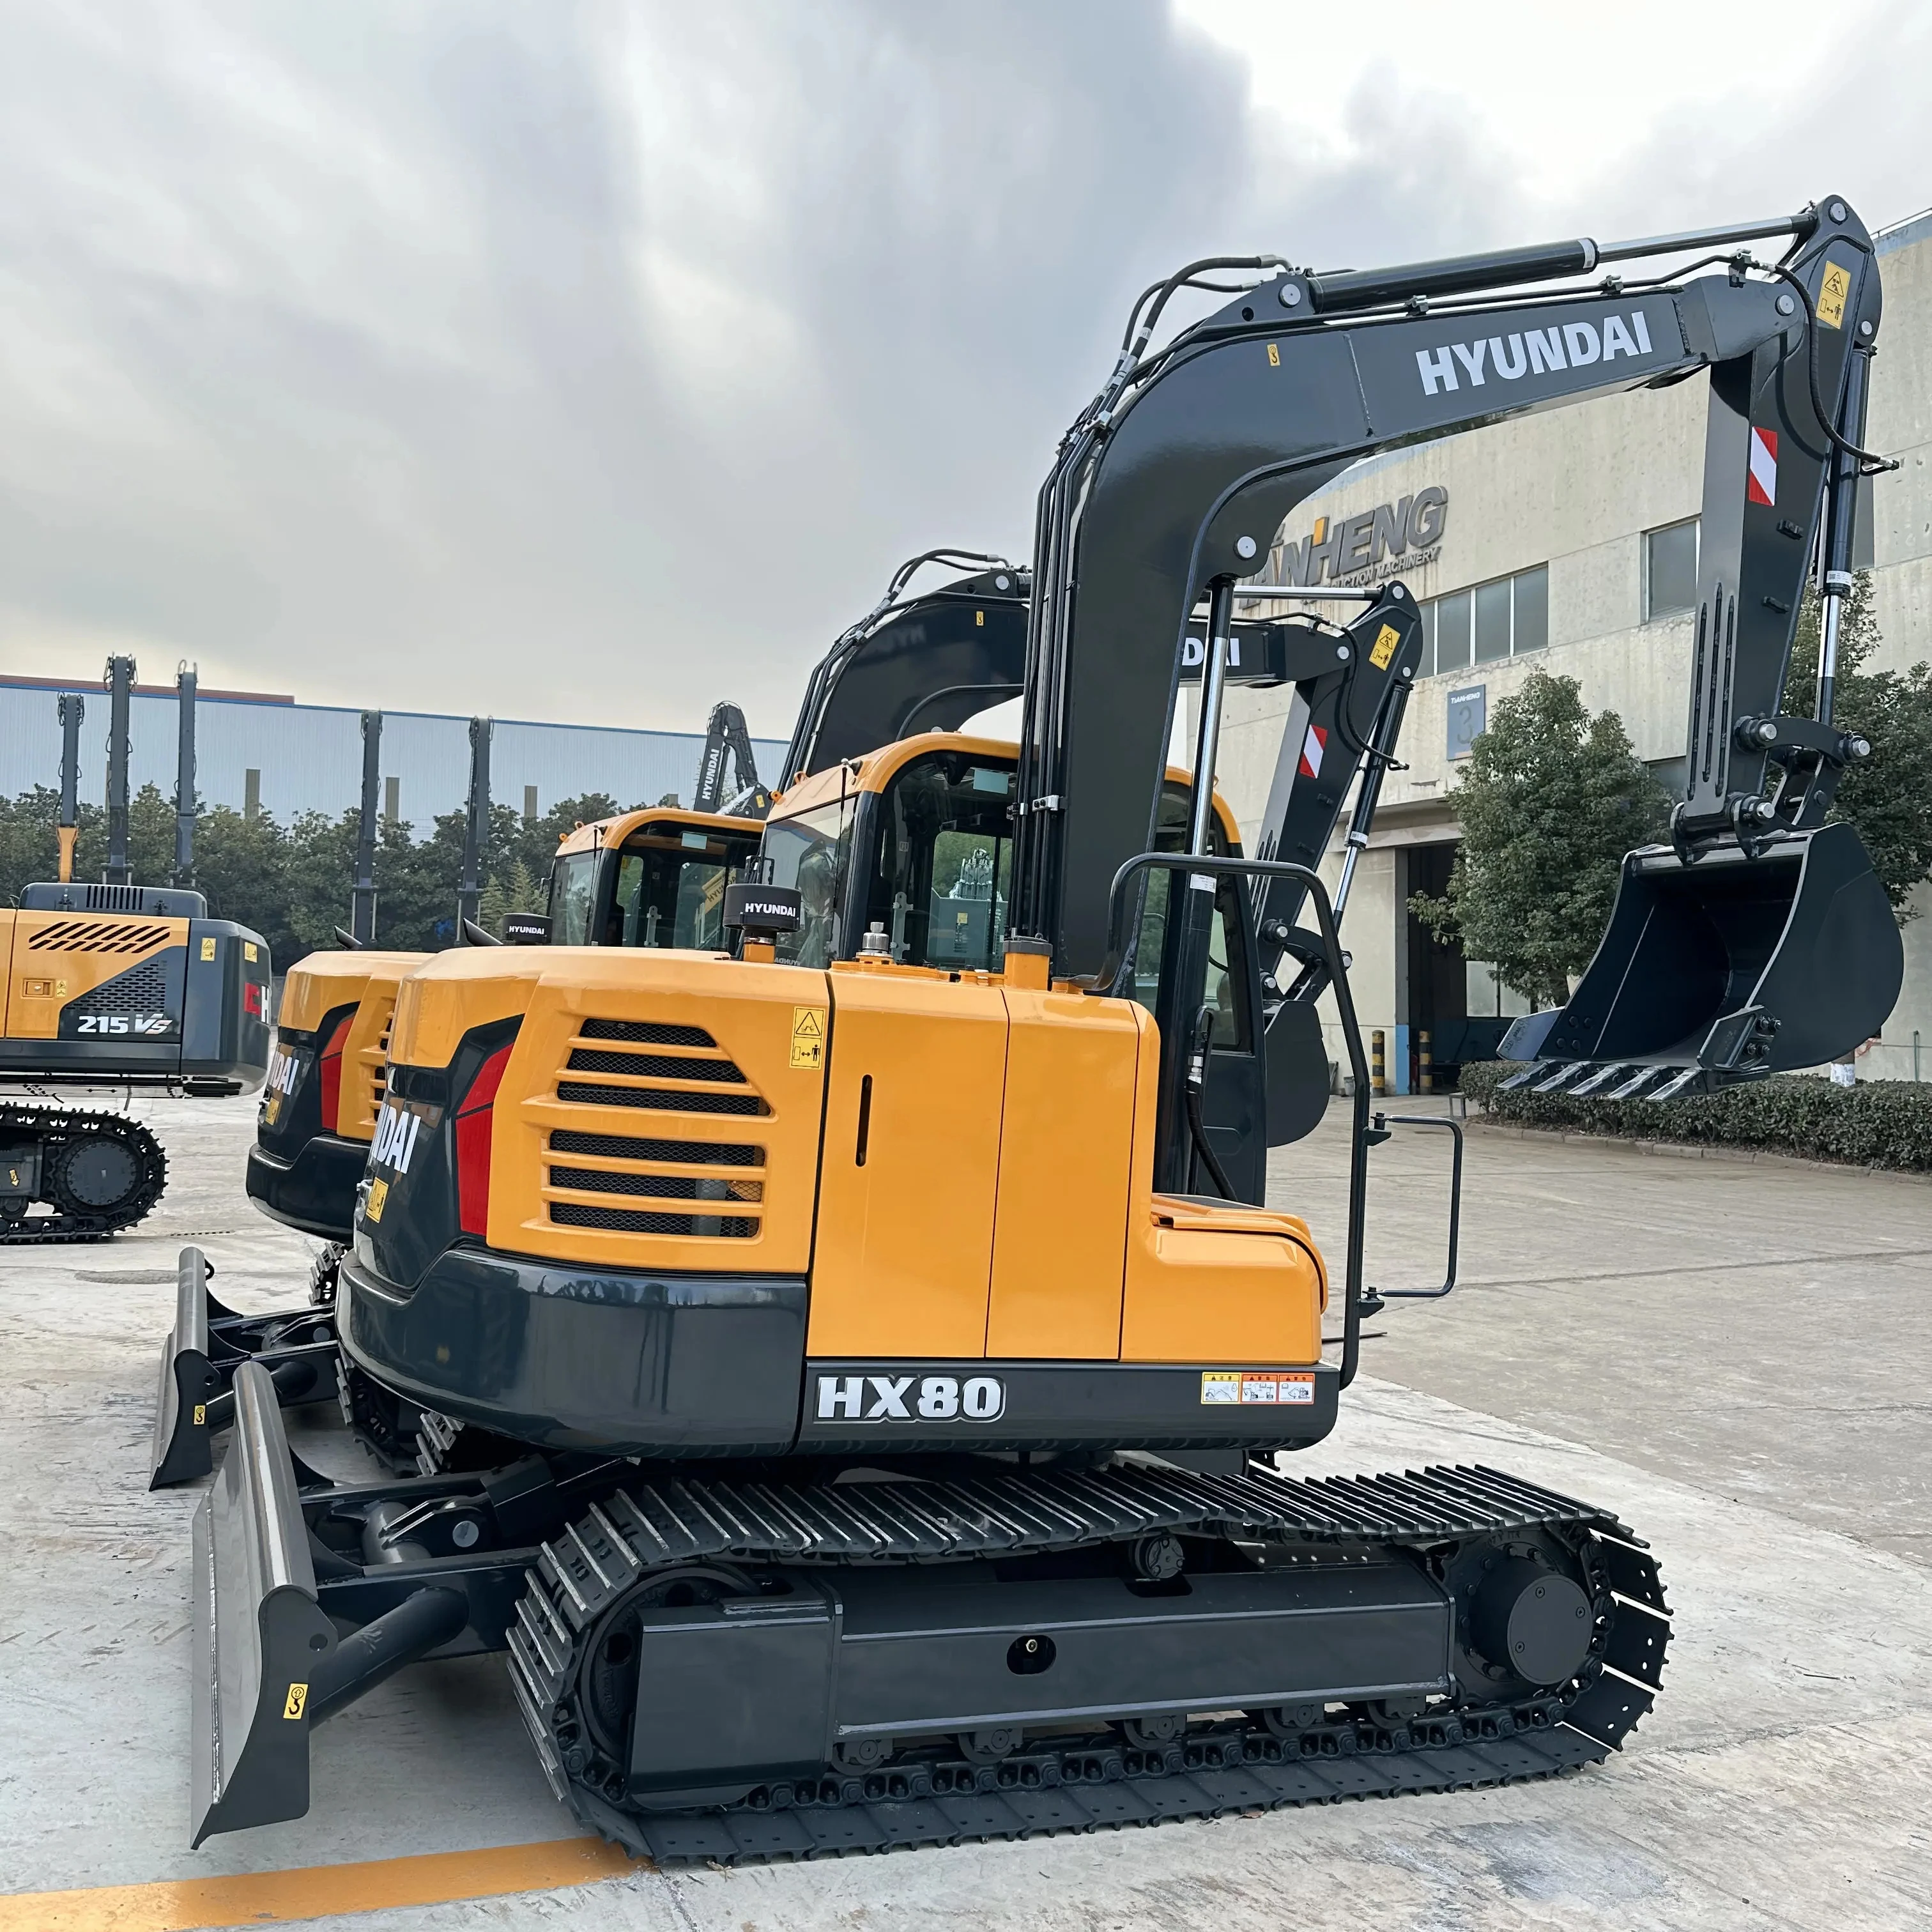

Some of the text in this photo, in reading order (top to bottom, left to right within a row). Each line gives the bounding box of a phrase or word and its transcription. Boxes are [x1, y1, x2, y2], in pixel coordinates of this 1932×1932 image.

[1415, 311, 1653, 395] HYUNDAI
[1375, 547, 1441, 579] MACHINERY
[1182, 638, 1240, 666] DI
[1457, 705, 1473, 744] 3
[702, 748, 720, 800] HYUNDAI
[745, 903, 797, 917] HYUNDAI
[509, 926, 545, 935] HYUNDAI
[77, 1016, 128, 1033] 215
[268, 1051, 299, 1095] DAI
[370, 1103, 421, 1174] DAI
[818, 1377, 1001, 1418] HX80
